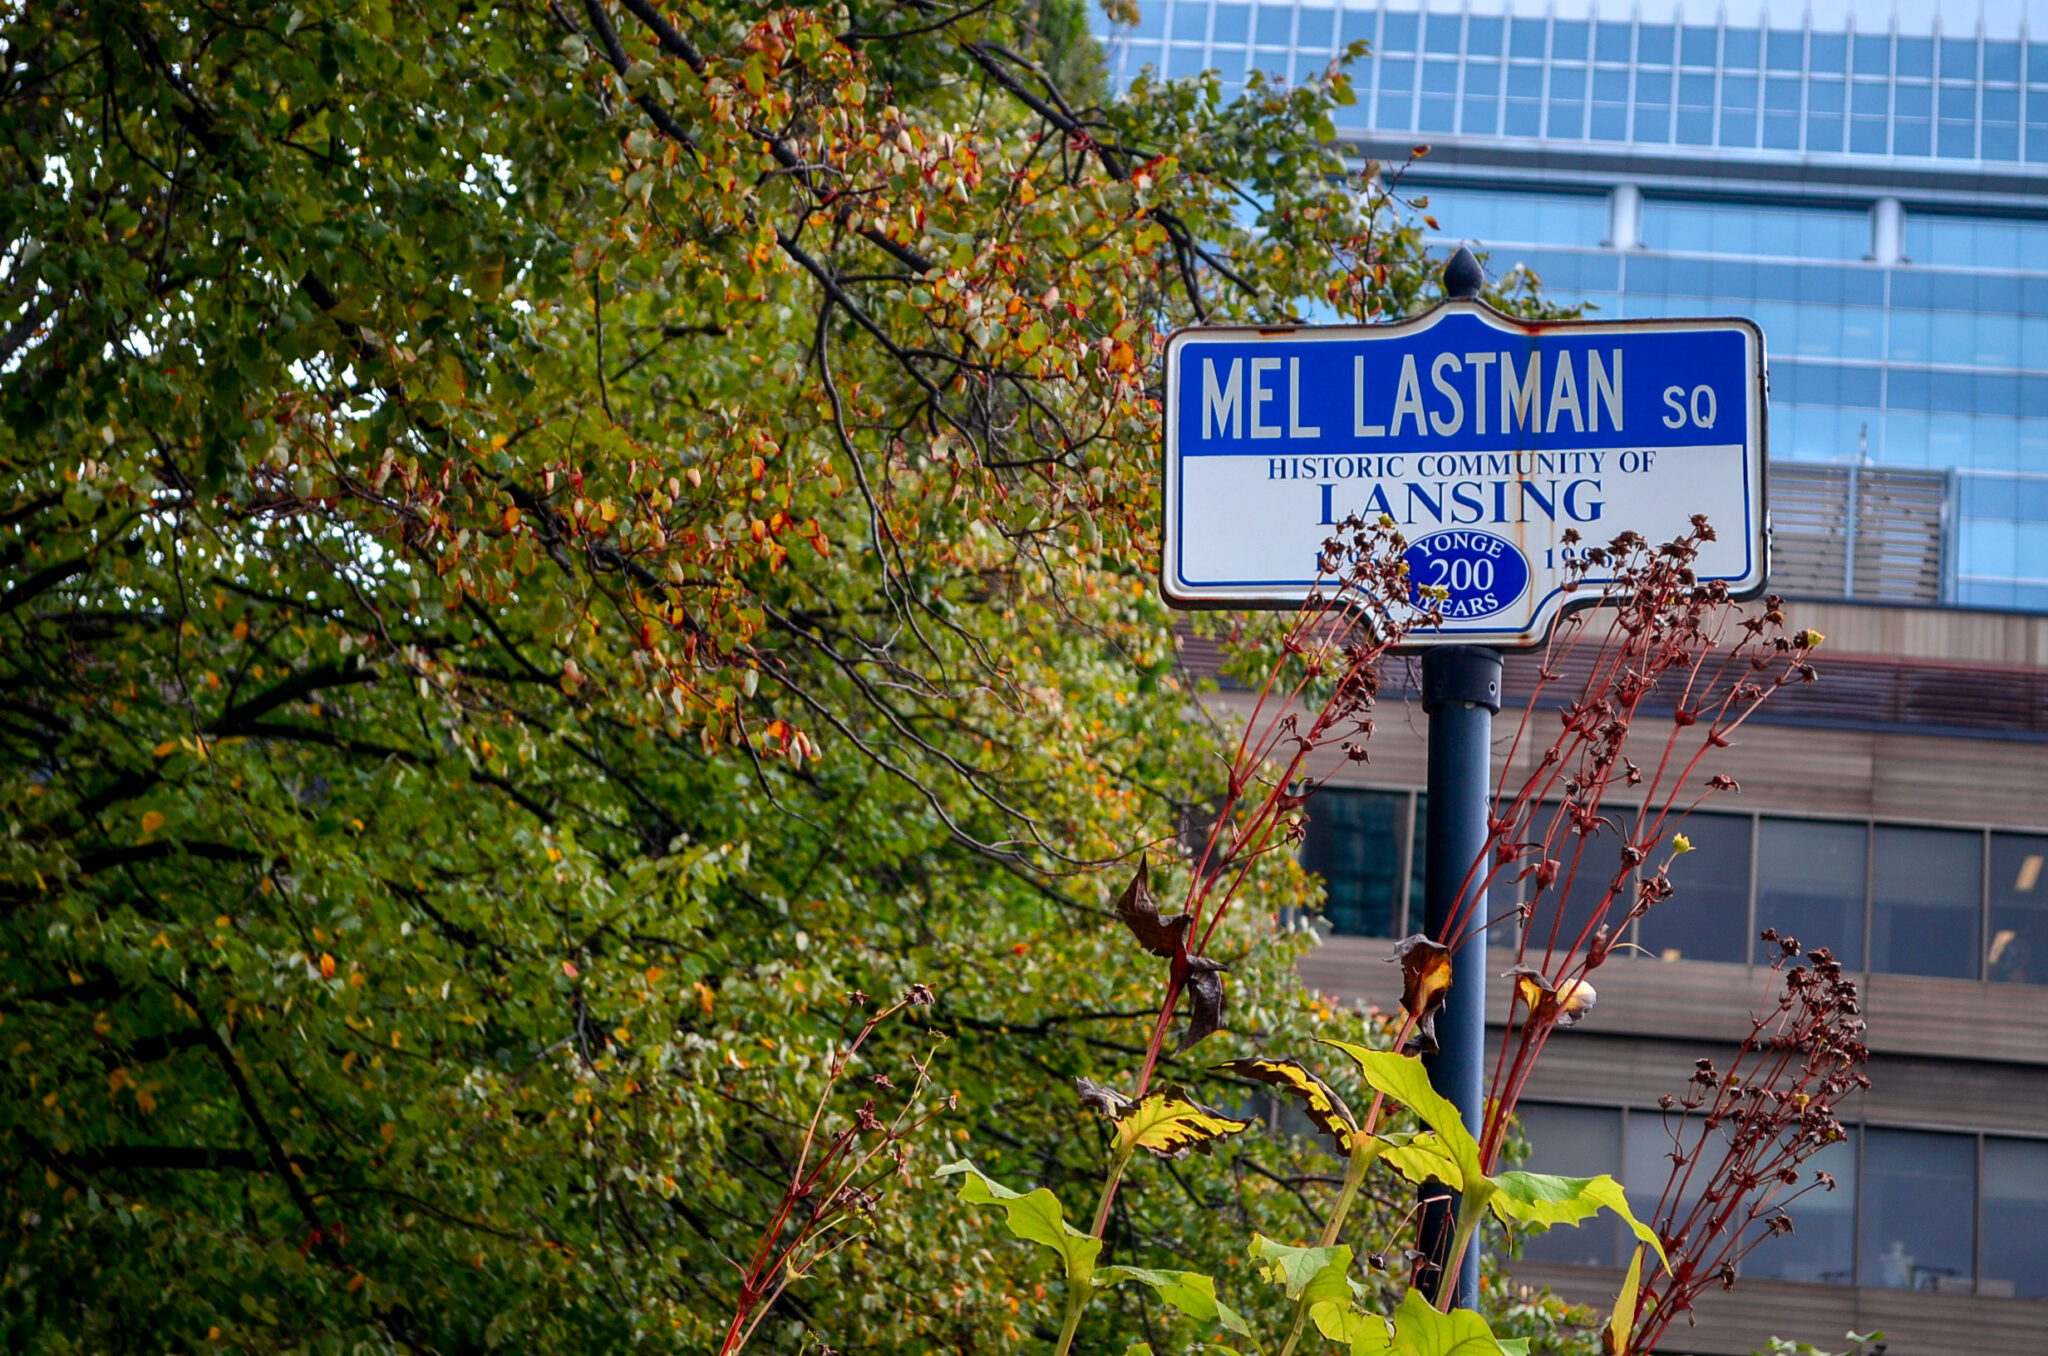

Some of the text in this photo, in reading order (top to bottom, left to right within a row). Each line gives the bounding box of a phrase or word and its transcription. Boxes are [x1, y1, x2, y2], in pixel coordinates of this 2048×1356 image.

[1202, 348, 1718, 440] MEL LASTMAN SQ
[1267, 450, 1657, 480] HISTORIC COMMUNITY OF
[1316, 479, 1606, 526] LANSING
[1313, 550, 1380, 572] 196
[1415, 532, 1505, 559] YONGE
[1428, 558, 1495, 592] 200
